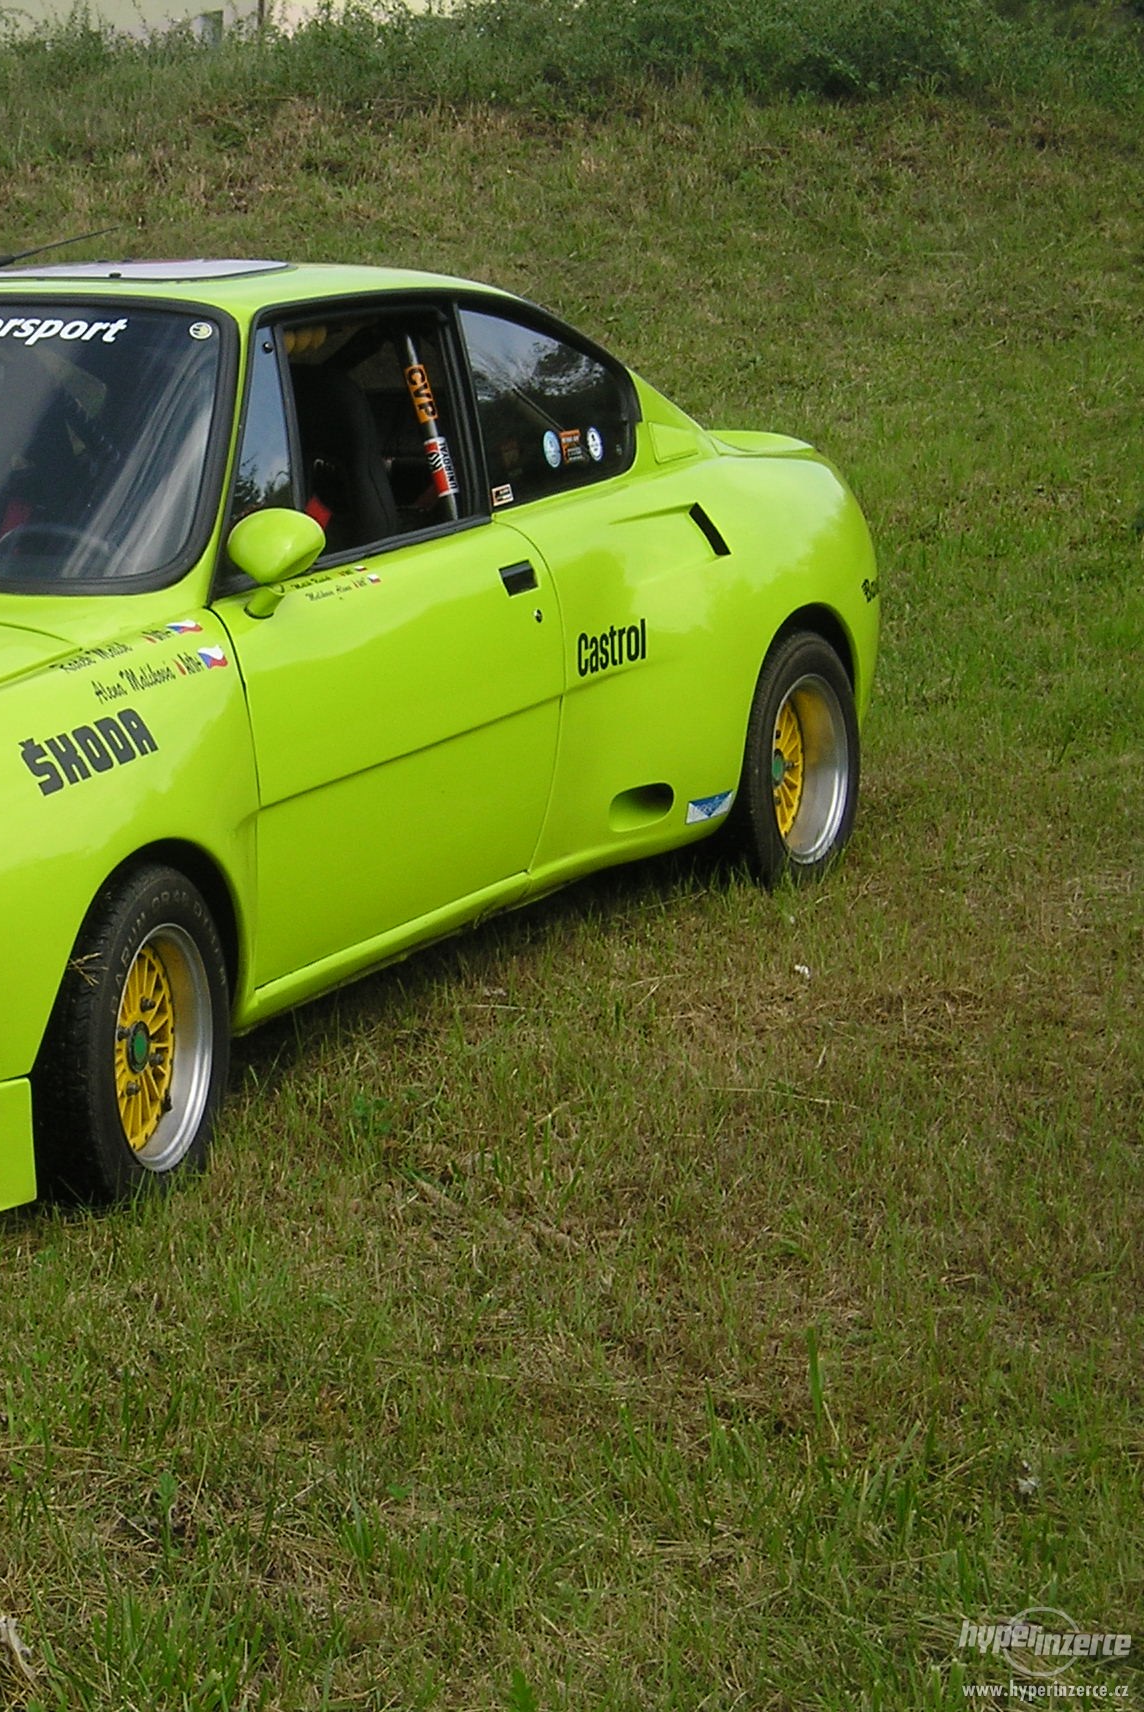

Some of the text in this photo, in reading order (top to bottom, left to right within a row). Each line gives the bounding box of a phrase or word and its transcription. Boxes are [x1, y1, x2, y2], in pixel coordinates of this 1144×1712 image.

[407, 367, 437, 418] CVP
[577, 618, 646, 678] Castrol
[18, 708, 159, 797] ŠKODA
